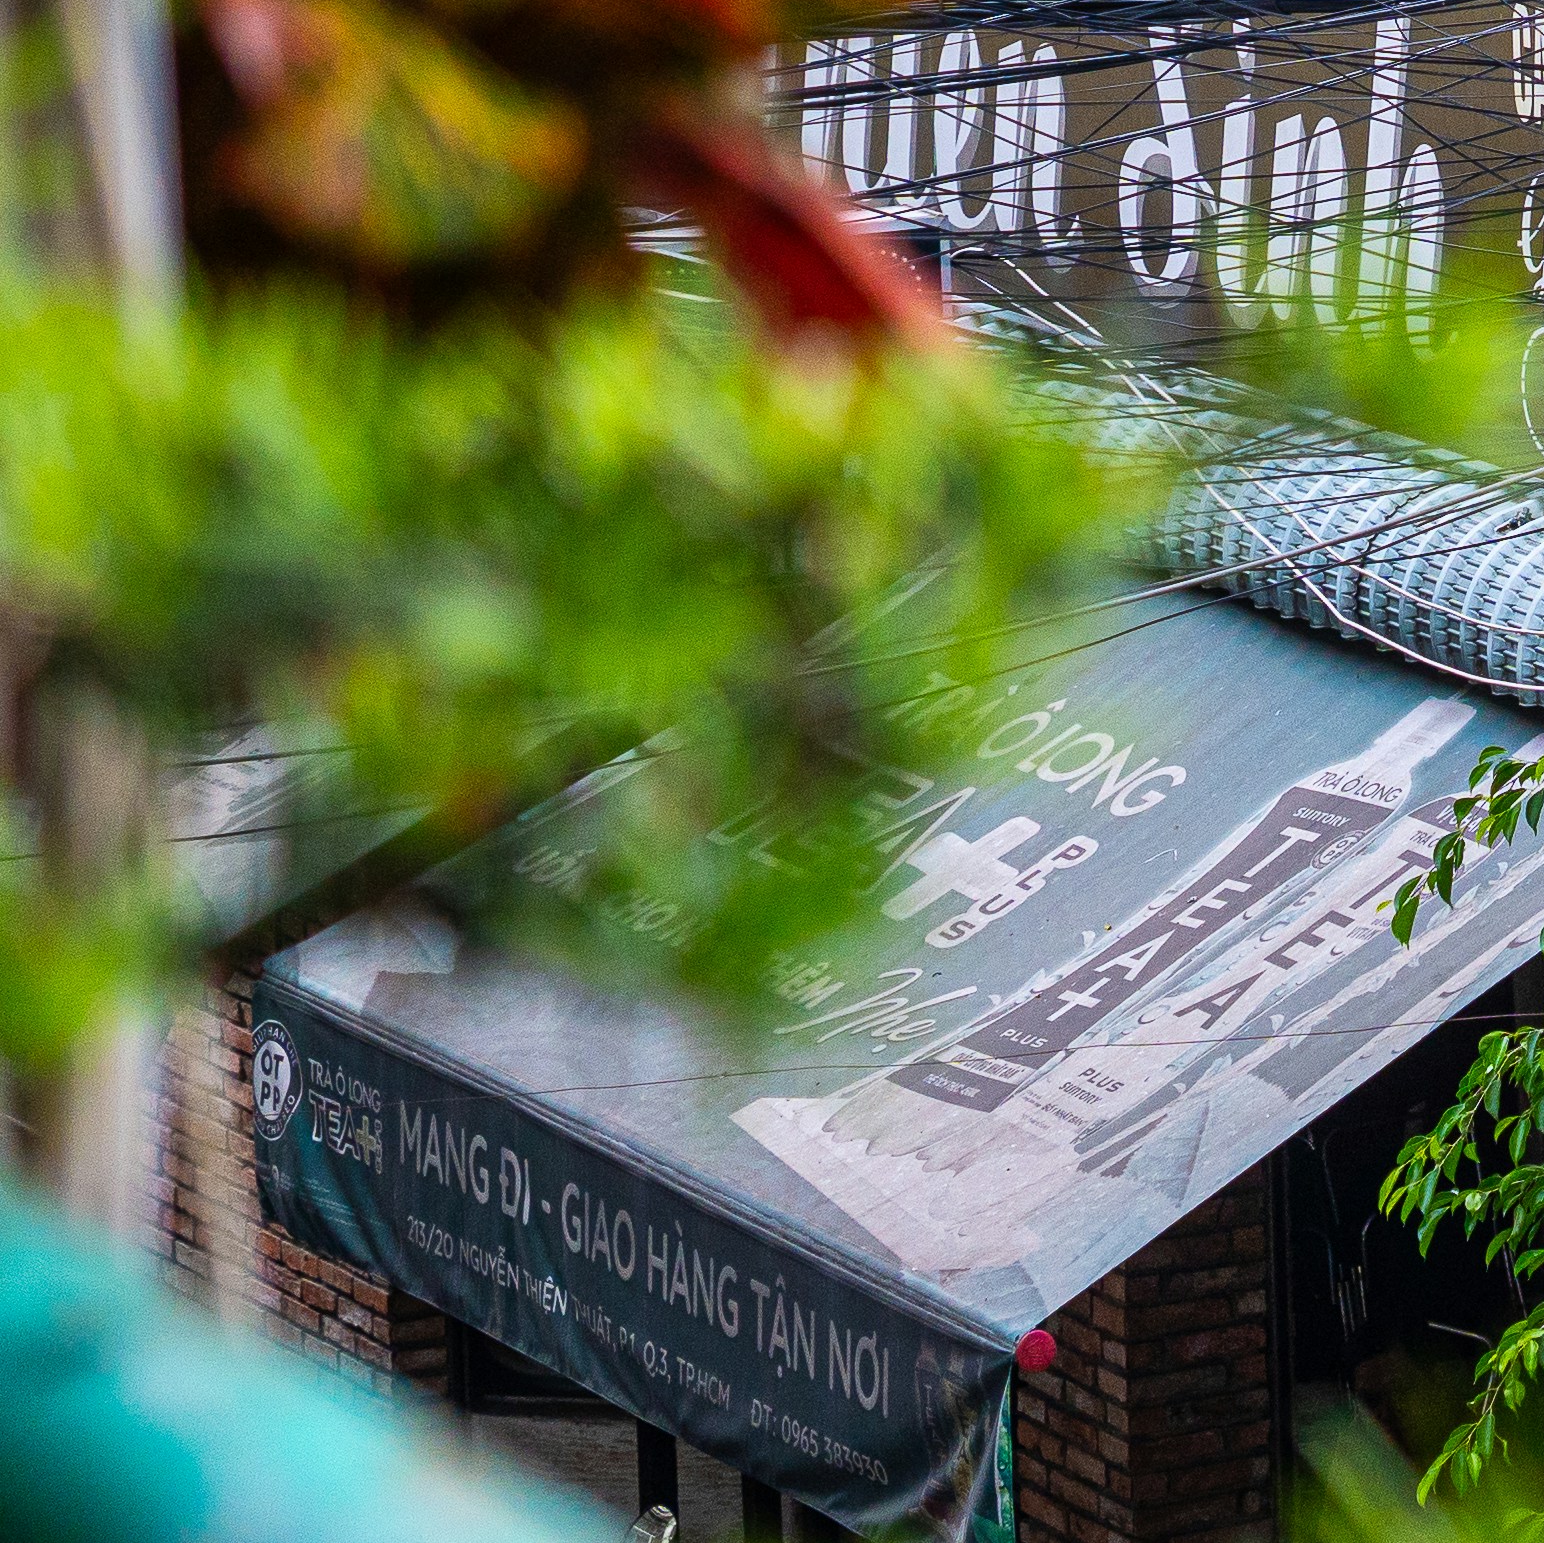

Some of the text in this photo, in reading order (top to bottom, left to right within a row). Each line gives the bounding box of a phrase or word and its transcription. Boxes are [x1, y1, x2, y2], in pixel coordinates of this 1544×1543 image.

[1312, 770, 1350, 790] TRÀ
[1354, 780, 1403, 803] LONG
[1292, 806, 1353, 828] SUNTORY
[1001, 1028, 1049, 1049] PLUS
[308, 1057, 334, 1091] TRÀ
[348, 1076, 382, 1114] LONG
[1058, 1081, 1103, 1105] SUNTORY
[1079, 1067, 1125, 1093] PLUS
[400, 1099, 490, 1207] MANG
[498, 1146, 531, 1226] ĐI
[560, 1182, 637, 1282] GIAO
[647, 1219, 740, 1339] HÀNG
[750, 1273, 816, 1381] TẬN
[406, 1215, 454, 1261] 213/20
[780, 1415, 820, 1458] 0965
